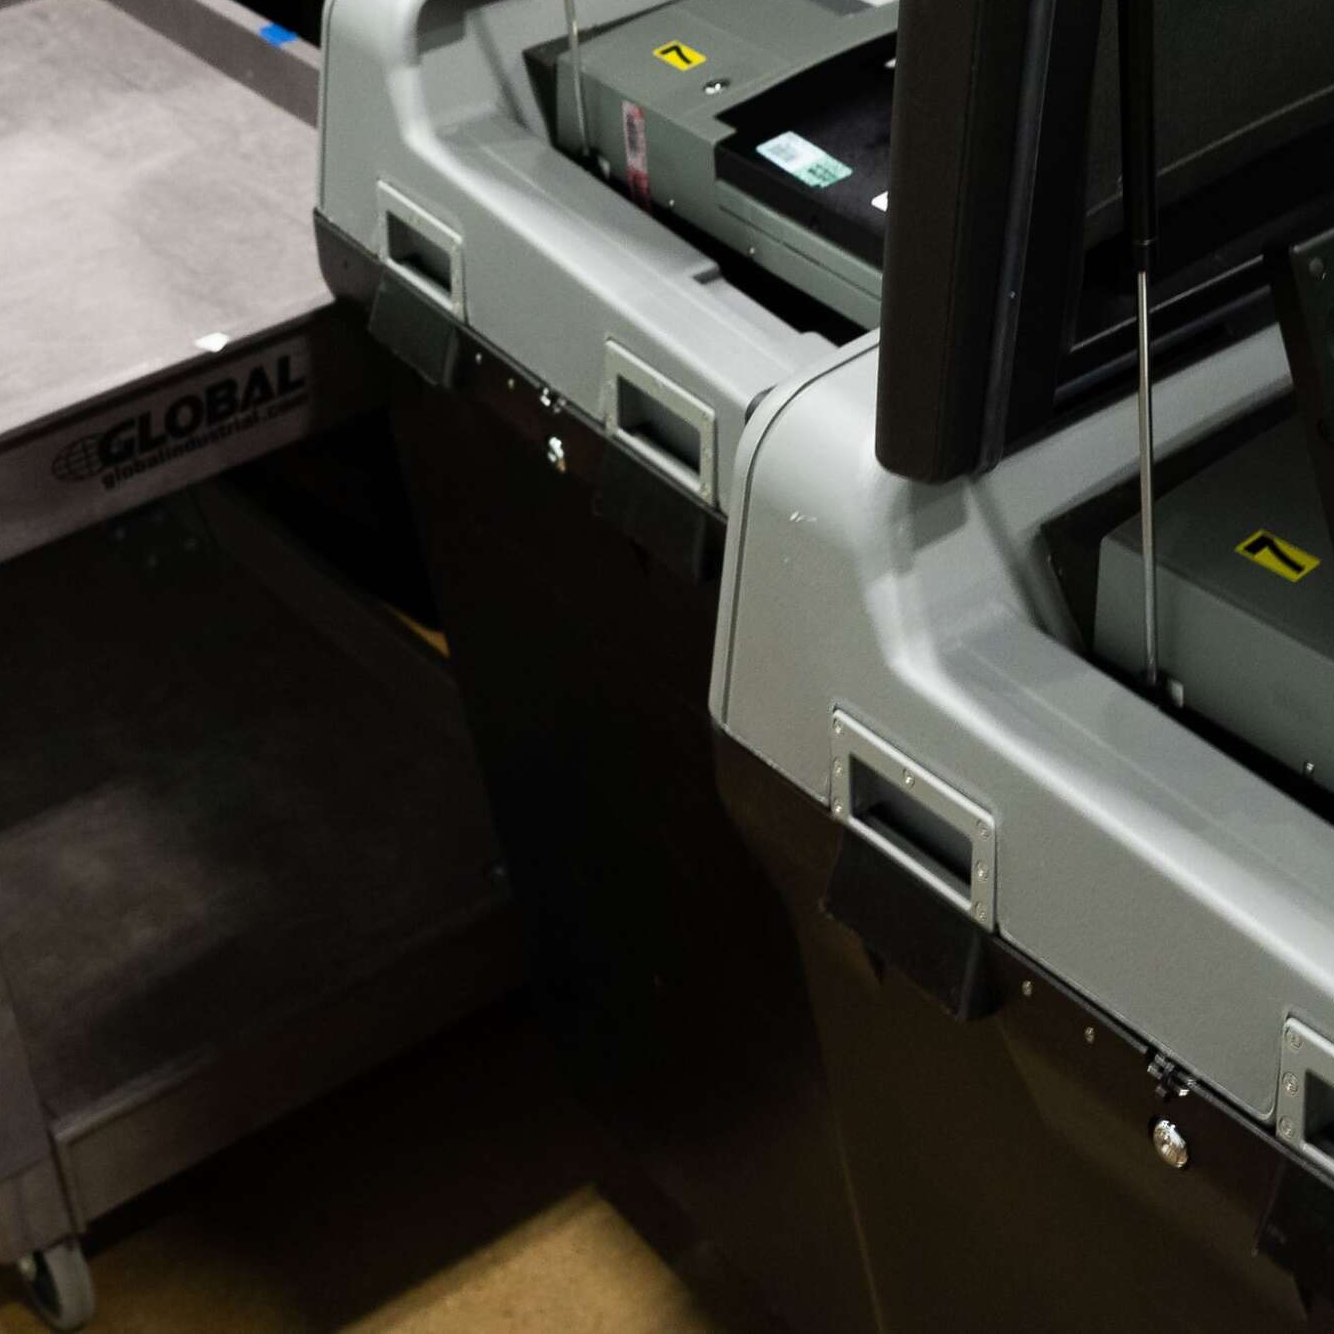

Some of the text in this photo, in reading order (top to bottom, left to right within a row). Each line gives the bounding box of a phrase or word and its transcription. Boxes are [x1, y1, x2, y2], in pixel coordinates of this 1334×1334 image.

[661, 45, 692, 64] 7
[99, 356, 306, 462] GLOBAL
[1244, 534, 1309, 574] 7
